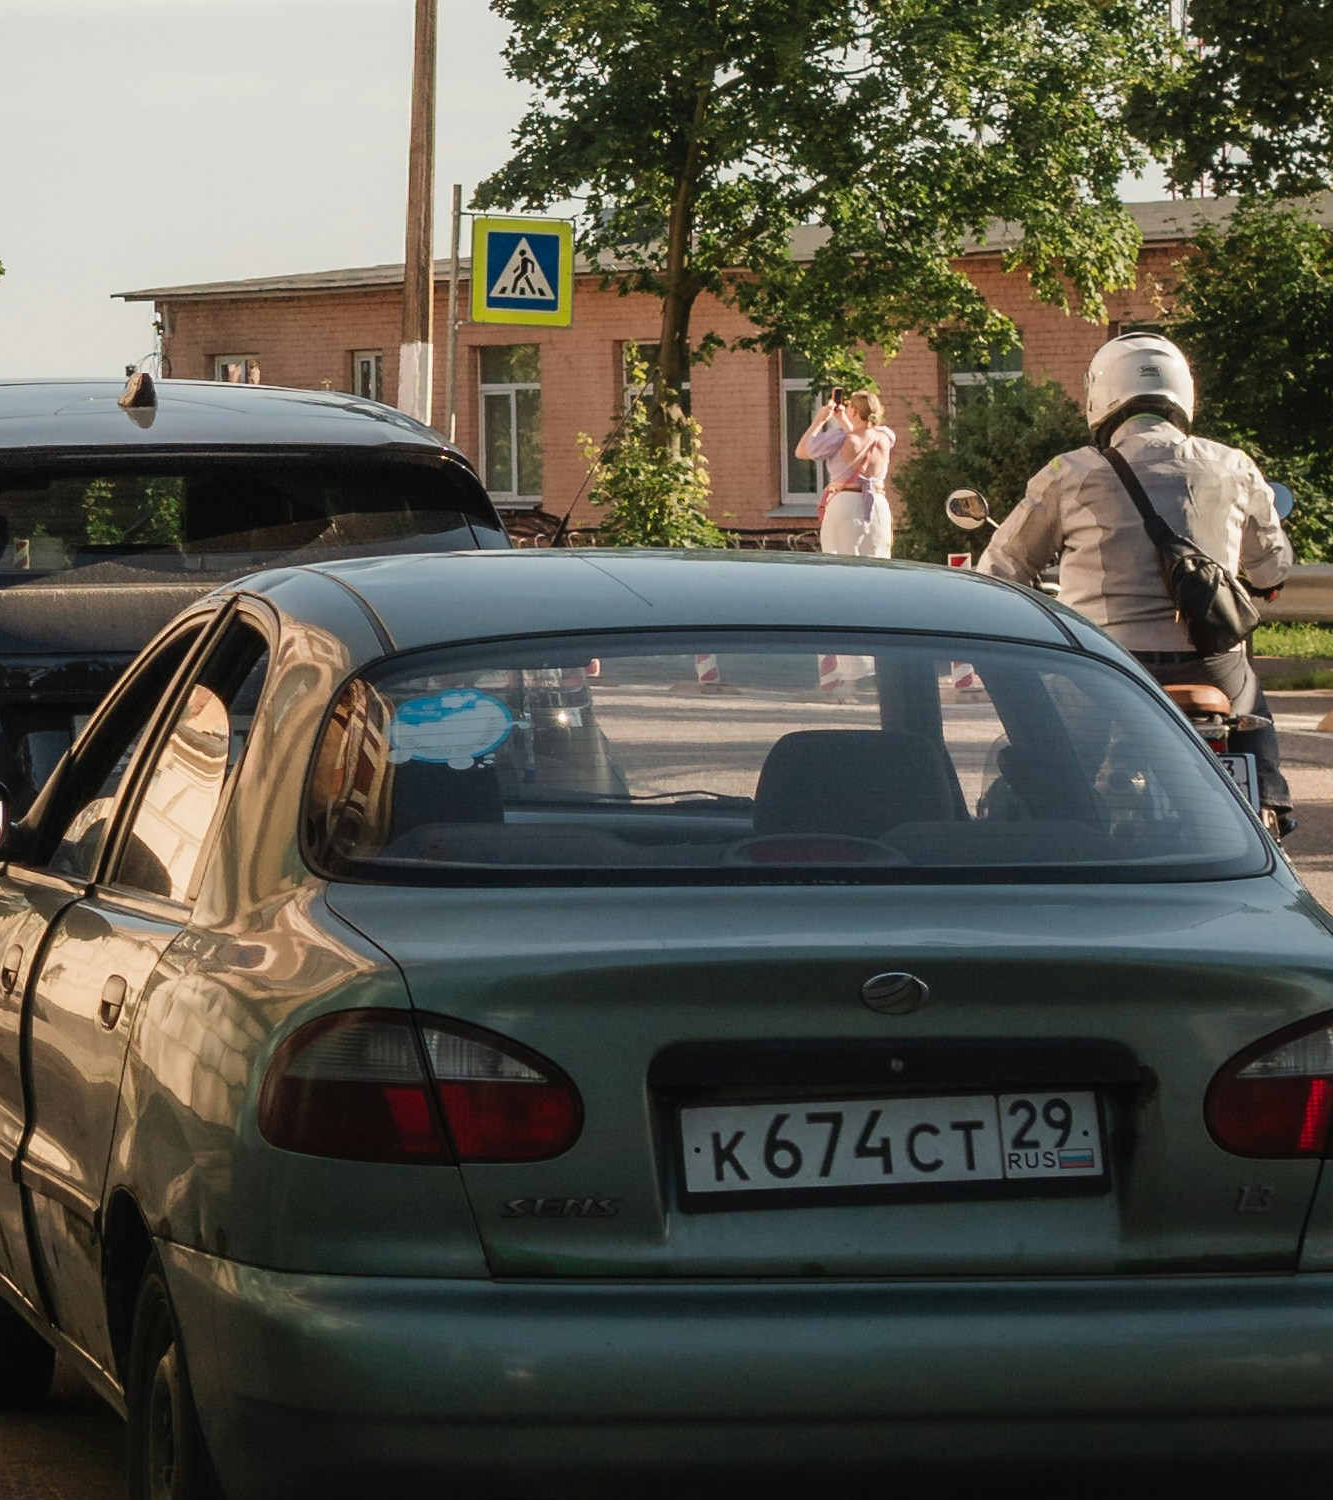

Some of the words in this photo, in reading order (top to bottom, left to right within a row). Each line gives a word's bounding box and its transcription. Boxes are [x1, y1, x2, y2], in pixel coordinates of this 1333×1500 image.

[710, 1108, 985, 1182] К674СТ
[1008, 1097, 1074, 1150] 29
[1007, 1149, 1057, 1170] RUS
